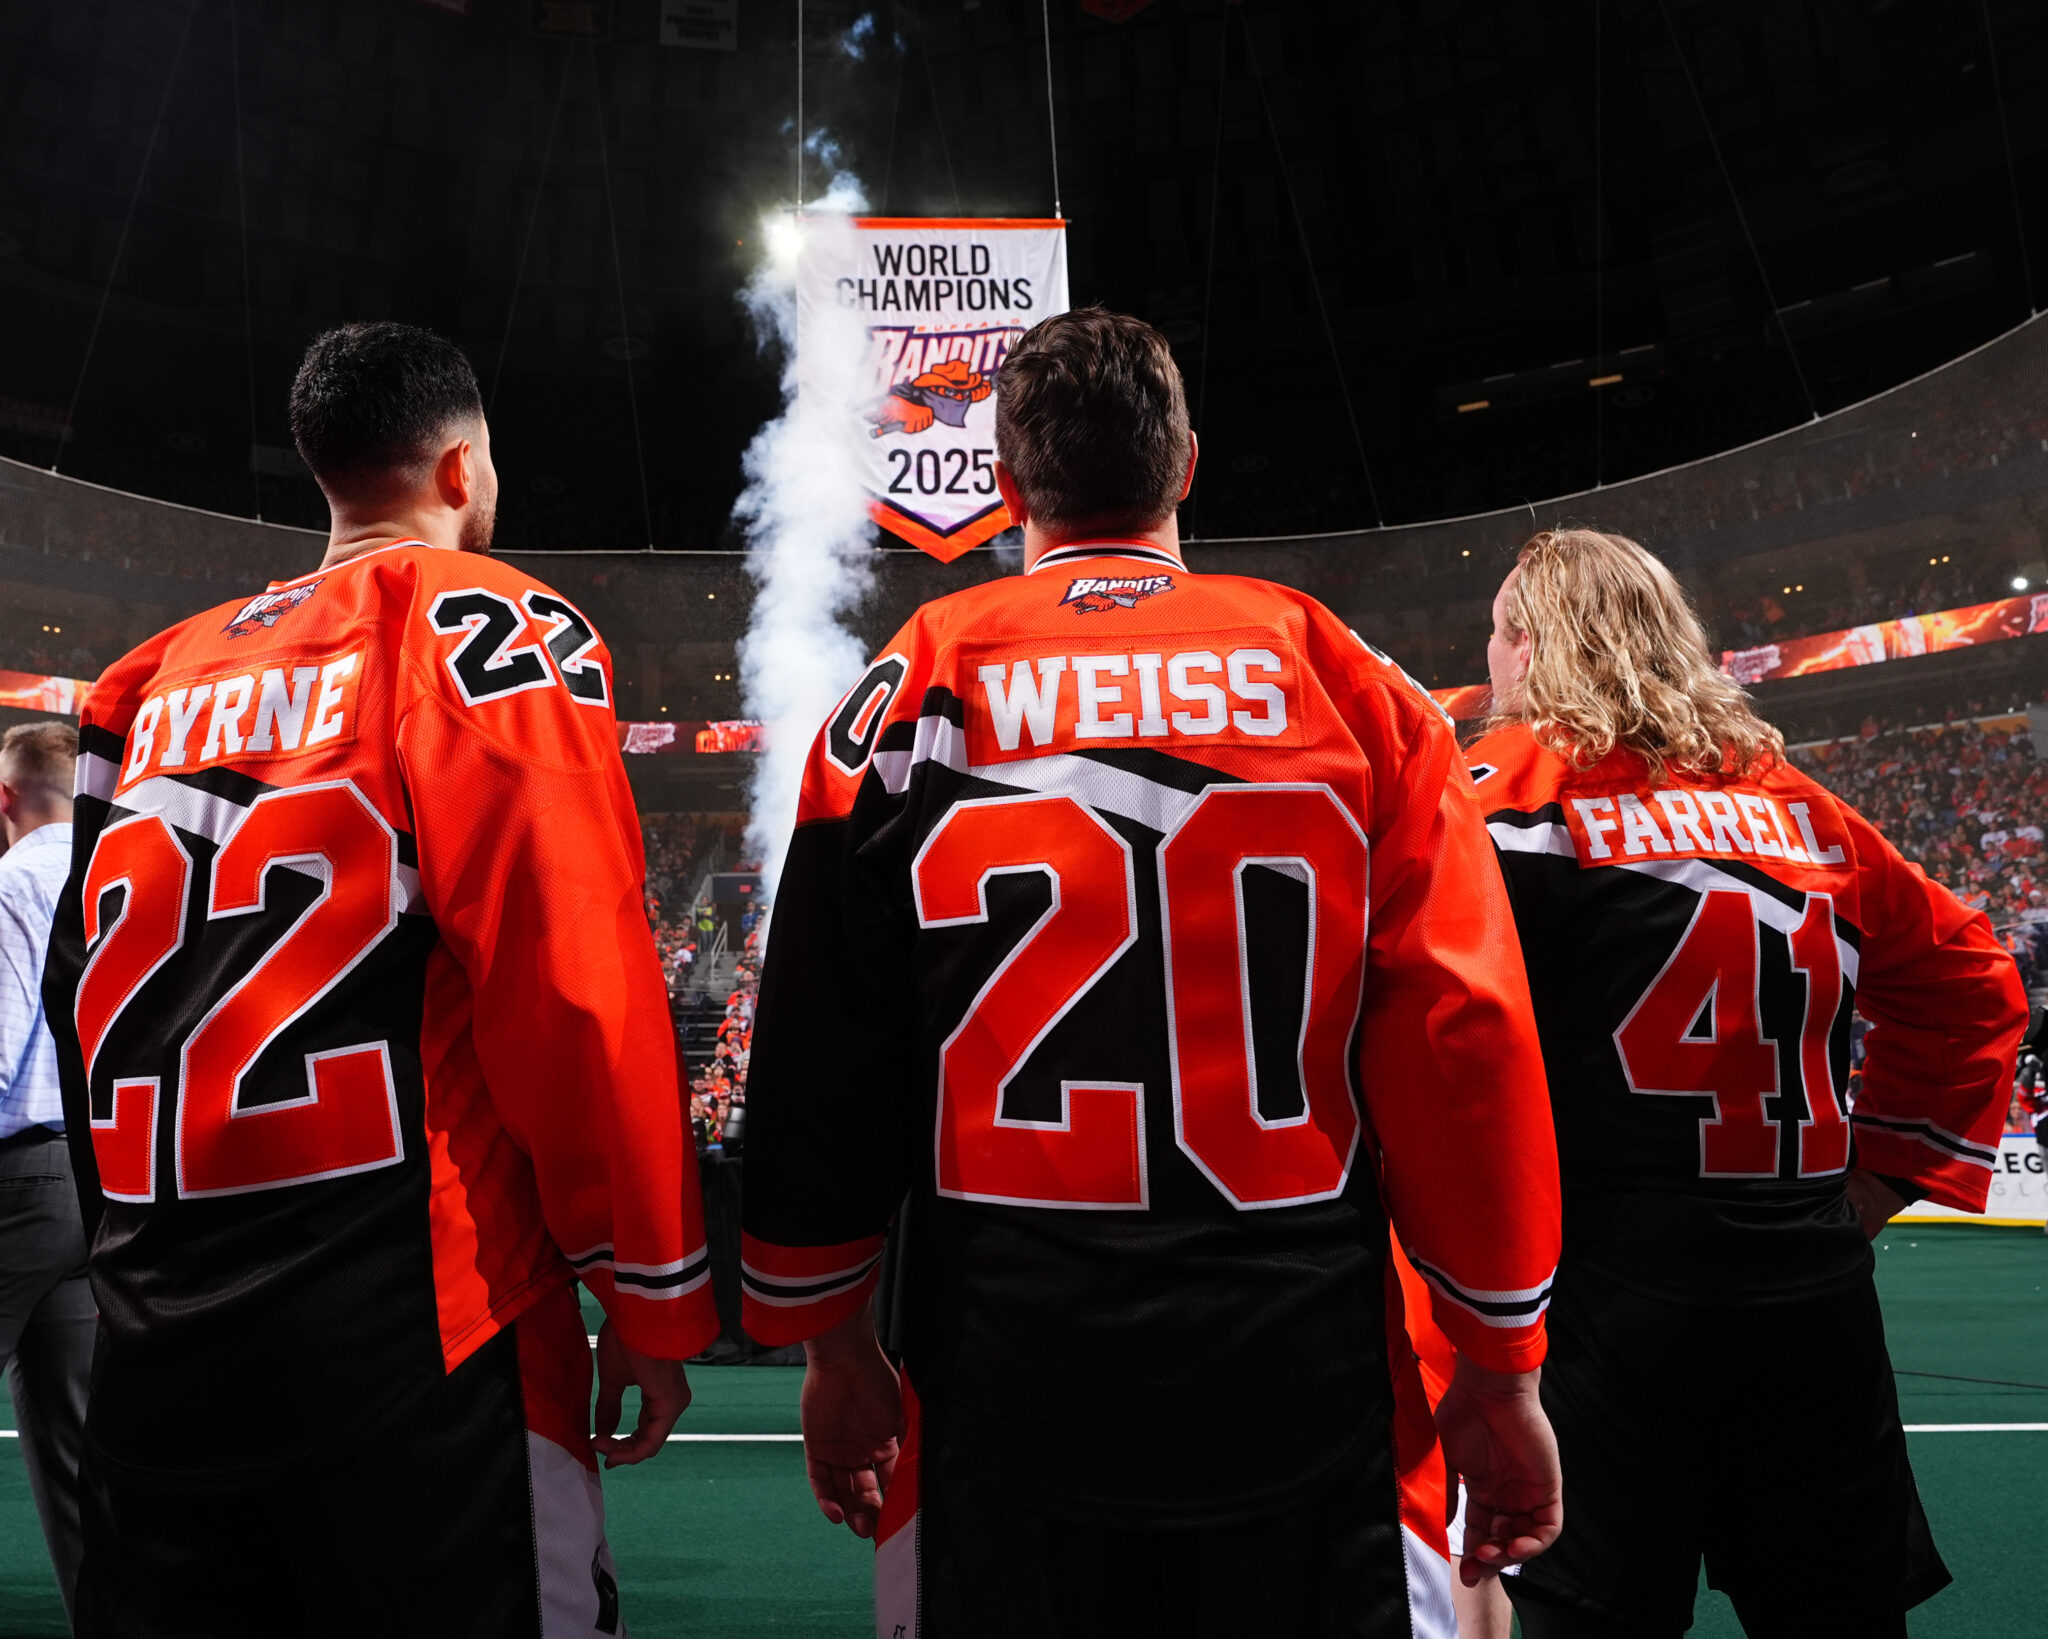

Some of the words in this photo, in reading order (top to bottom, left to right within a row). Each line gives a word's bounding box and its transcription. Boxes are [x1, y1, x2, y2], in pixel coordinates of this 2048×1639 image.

[836, 277, 1033, 312] CHAMPIONS
[872, 244, 990, 276] WORLD
[917, 317, 1022, 333] BUFFALO
[887, 447, 997, 496] 2025
[1064, 575, 1170, 602] BANDITS
[425, 586, 610, 708] 22
[122, 651, 358, 786] BYRNE
[977, 648, 1289, 752] WEISS
[1570, 789, 1847, 865] FARRELL
[74, 778, 405, 1204] 22
[911, 782, 1370, 1211] 20
[1612, 885, 1850, 1179] 41
